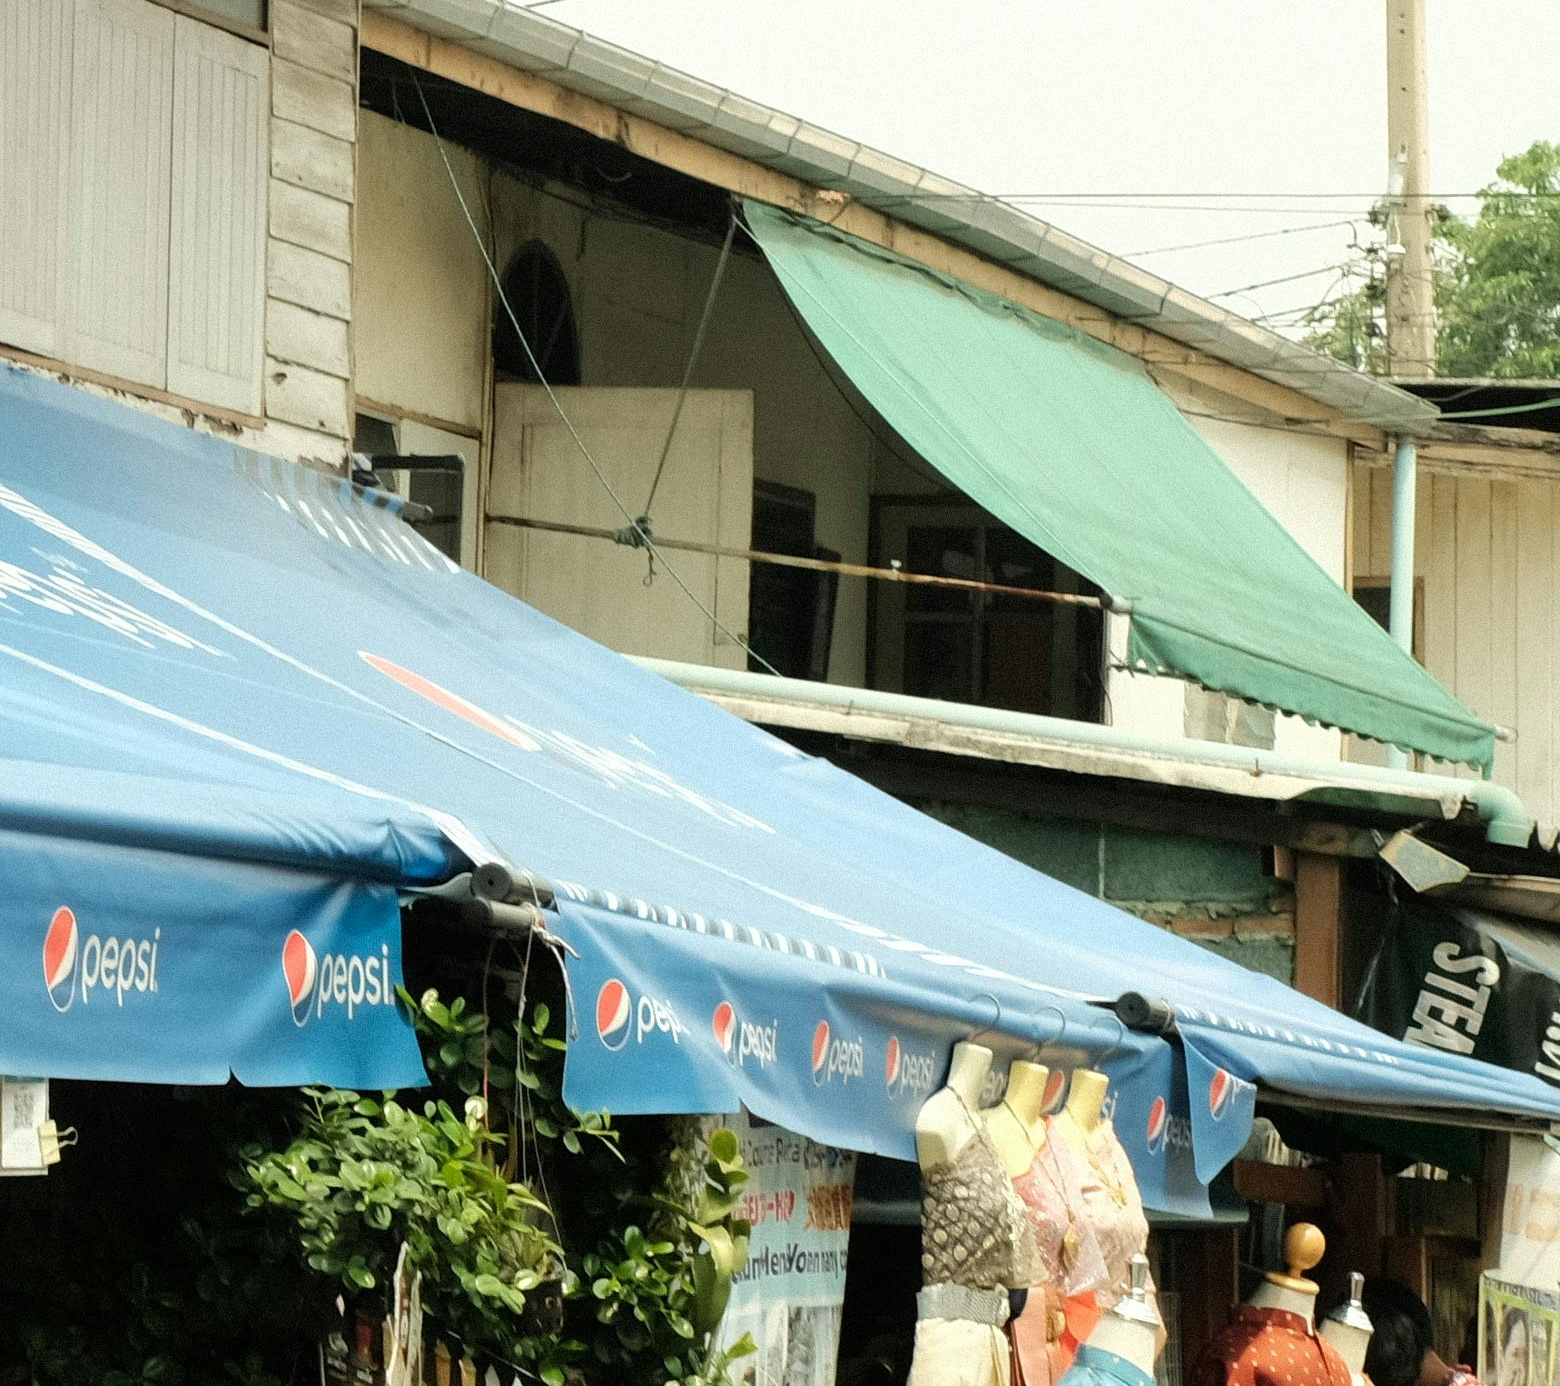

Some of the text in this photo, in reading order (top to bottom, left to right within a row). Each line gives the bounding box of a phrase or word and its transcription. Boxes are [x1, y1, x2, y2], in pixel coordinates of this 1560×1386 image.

[80, 928, 162, 1007] pepsi
[317, 945, 394, 1026] pepsi
[1402, 941, 1501, 1056] STEA
[827, 1036, 864, 1082] pepsi
[899, 1051, 936, 1099] pepsi
